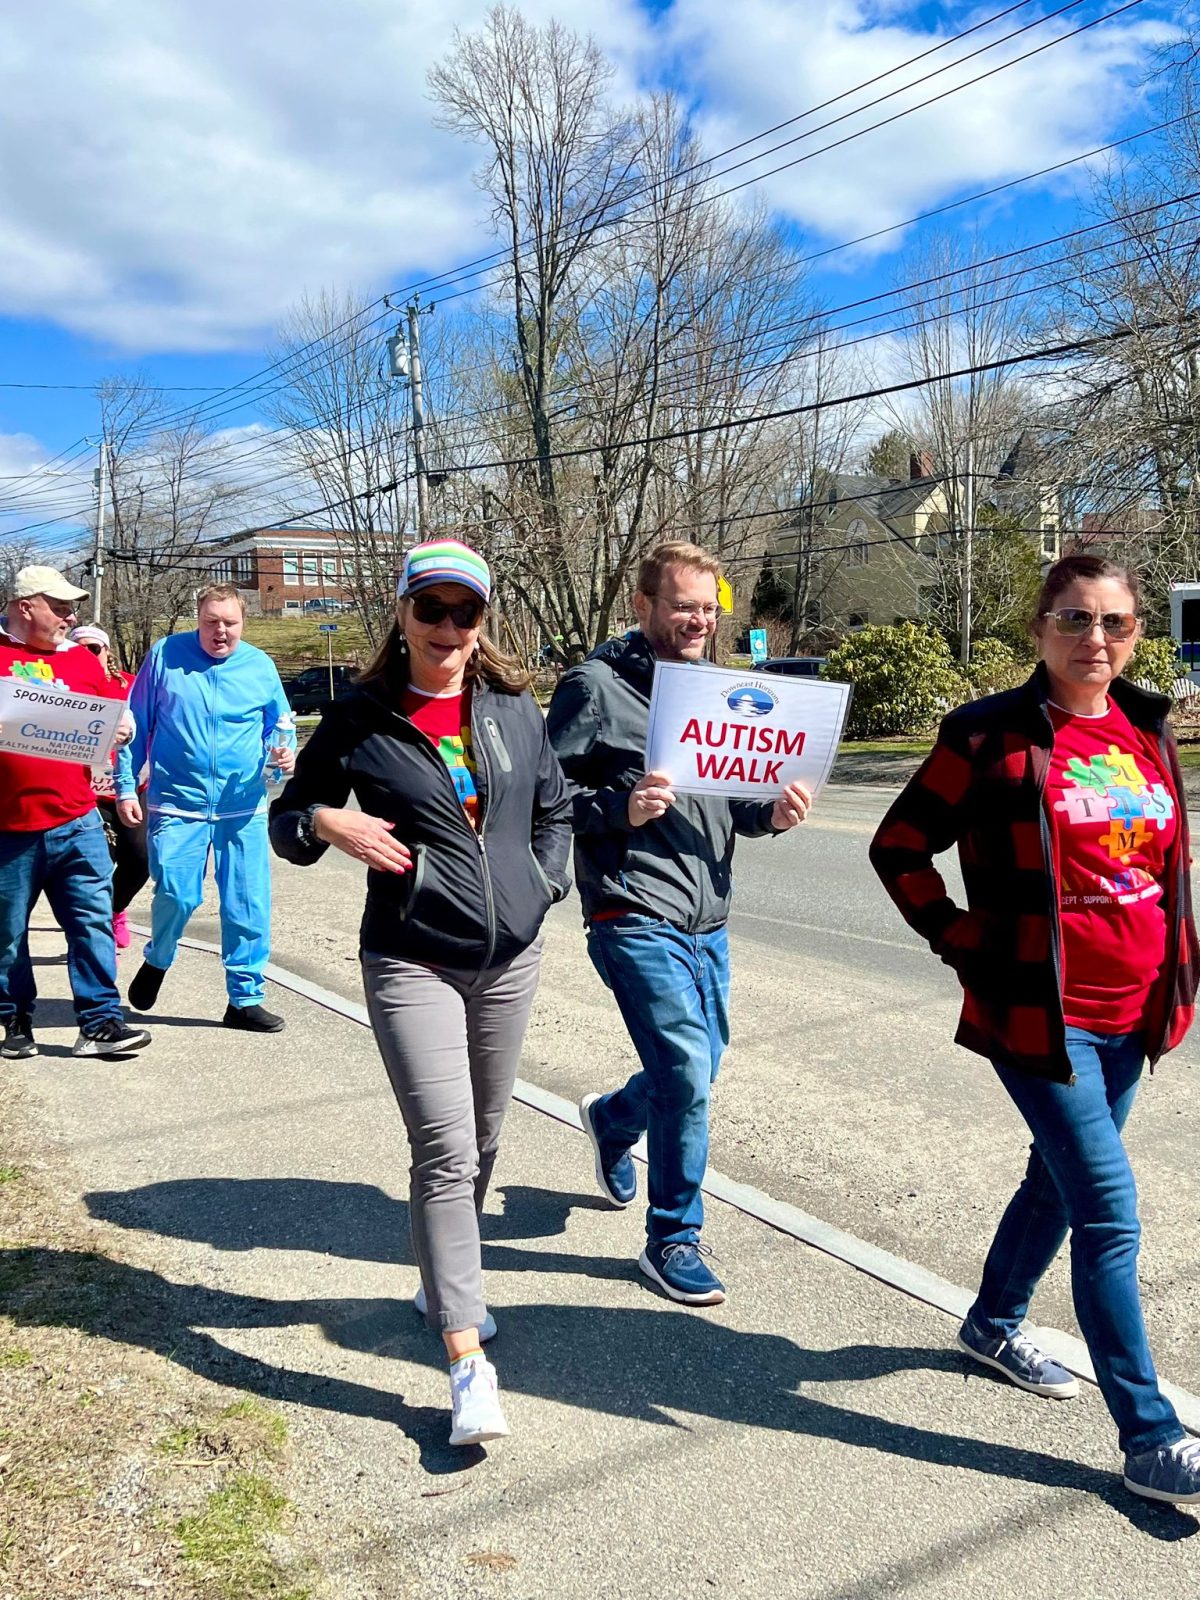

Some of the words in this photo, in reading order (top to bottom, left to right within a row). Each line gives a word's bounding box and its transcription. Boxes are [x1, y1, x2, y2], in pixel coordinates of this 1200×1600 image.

[13, 689, 88, 711] SPONSORED
[89, 703, 106, 713] BY
[720, 681, 754, 698] Downeast
[754, 680, 781, 705] Horizons
[20, 722, 100, 747] Camden
[679, 718, 806, 756] AUTISM
[31, 745, 95, 760] MANAGEMENT
[49, 741, 96, 754] NATIONAL
[696, 752, 785, 785] WALK
